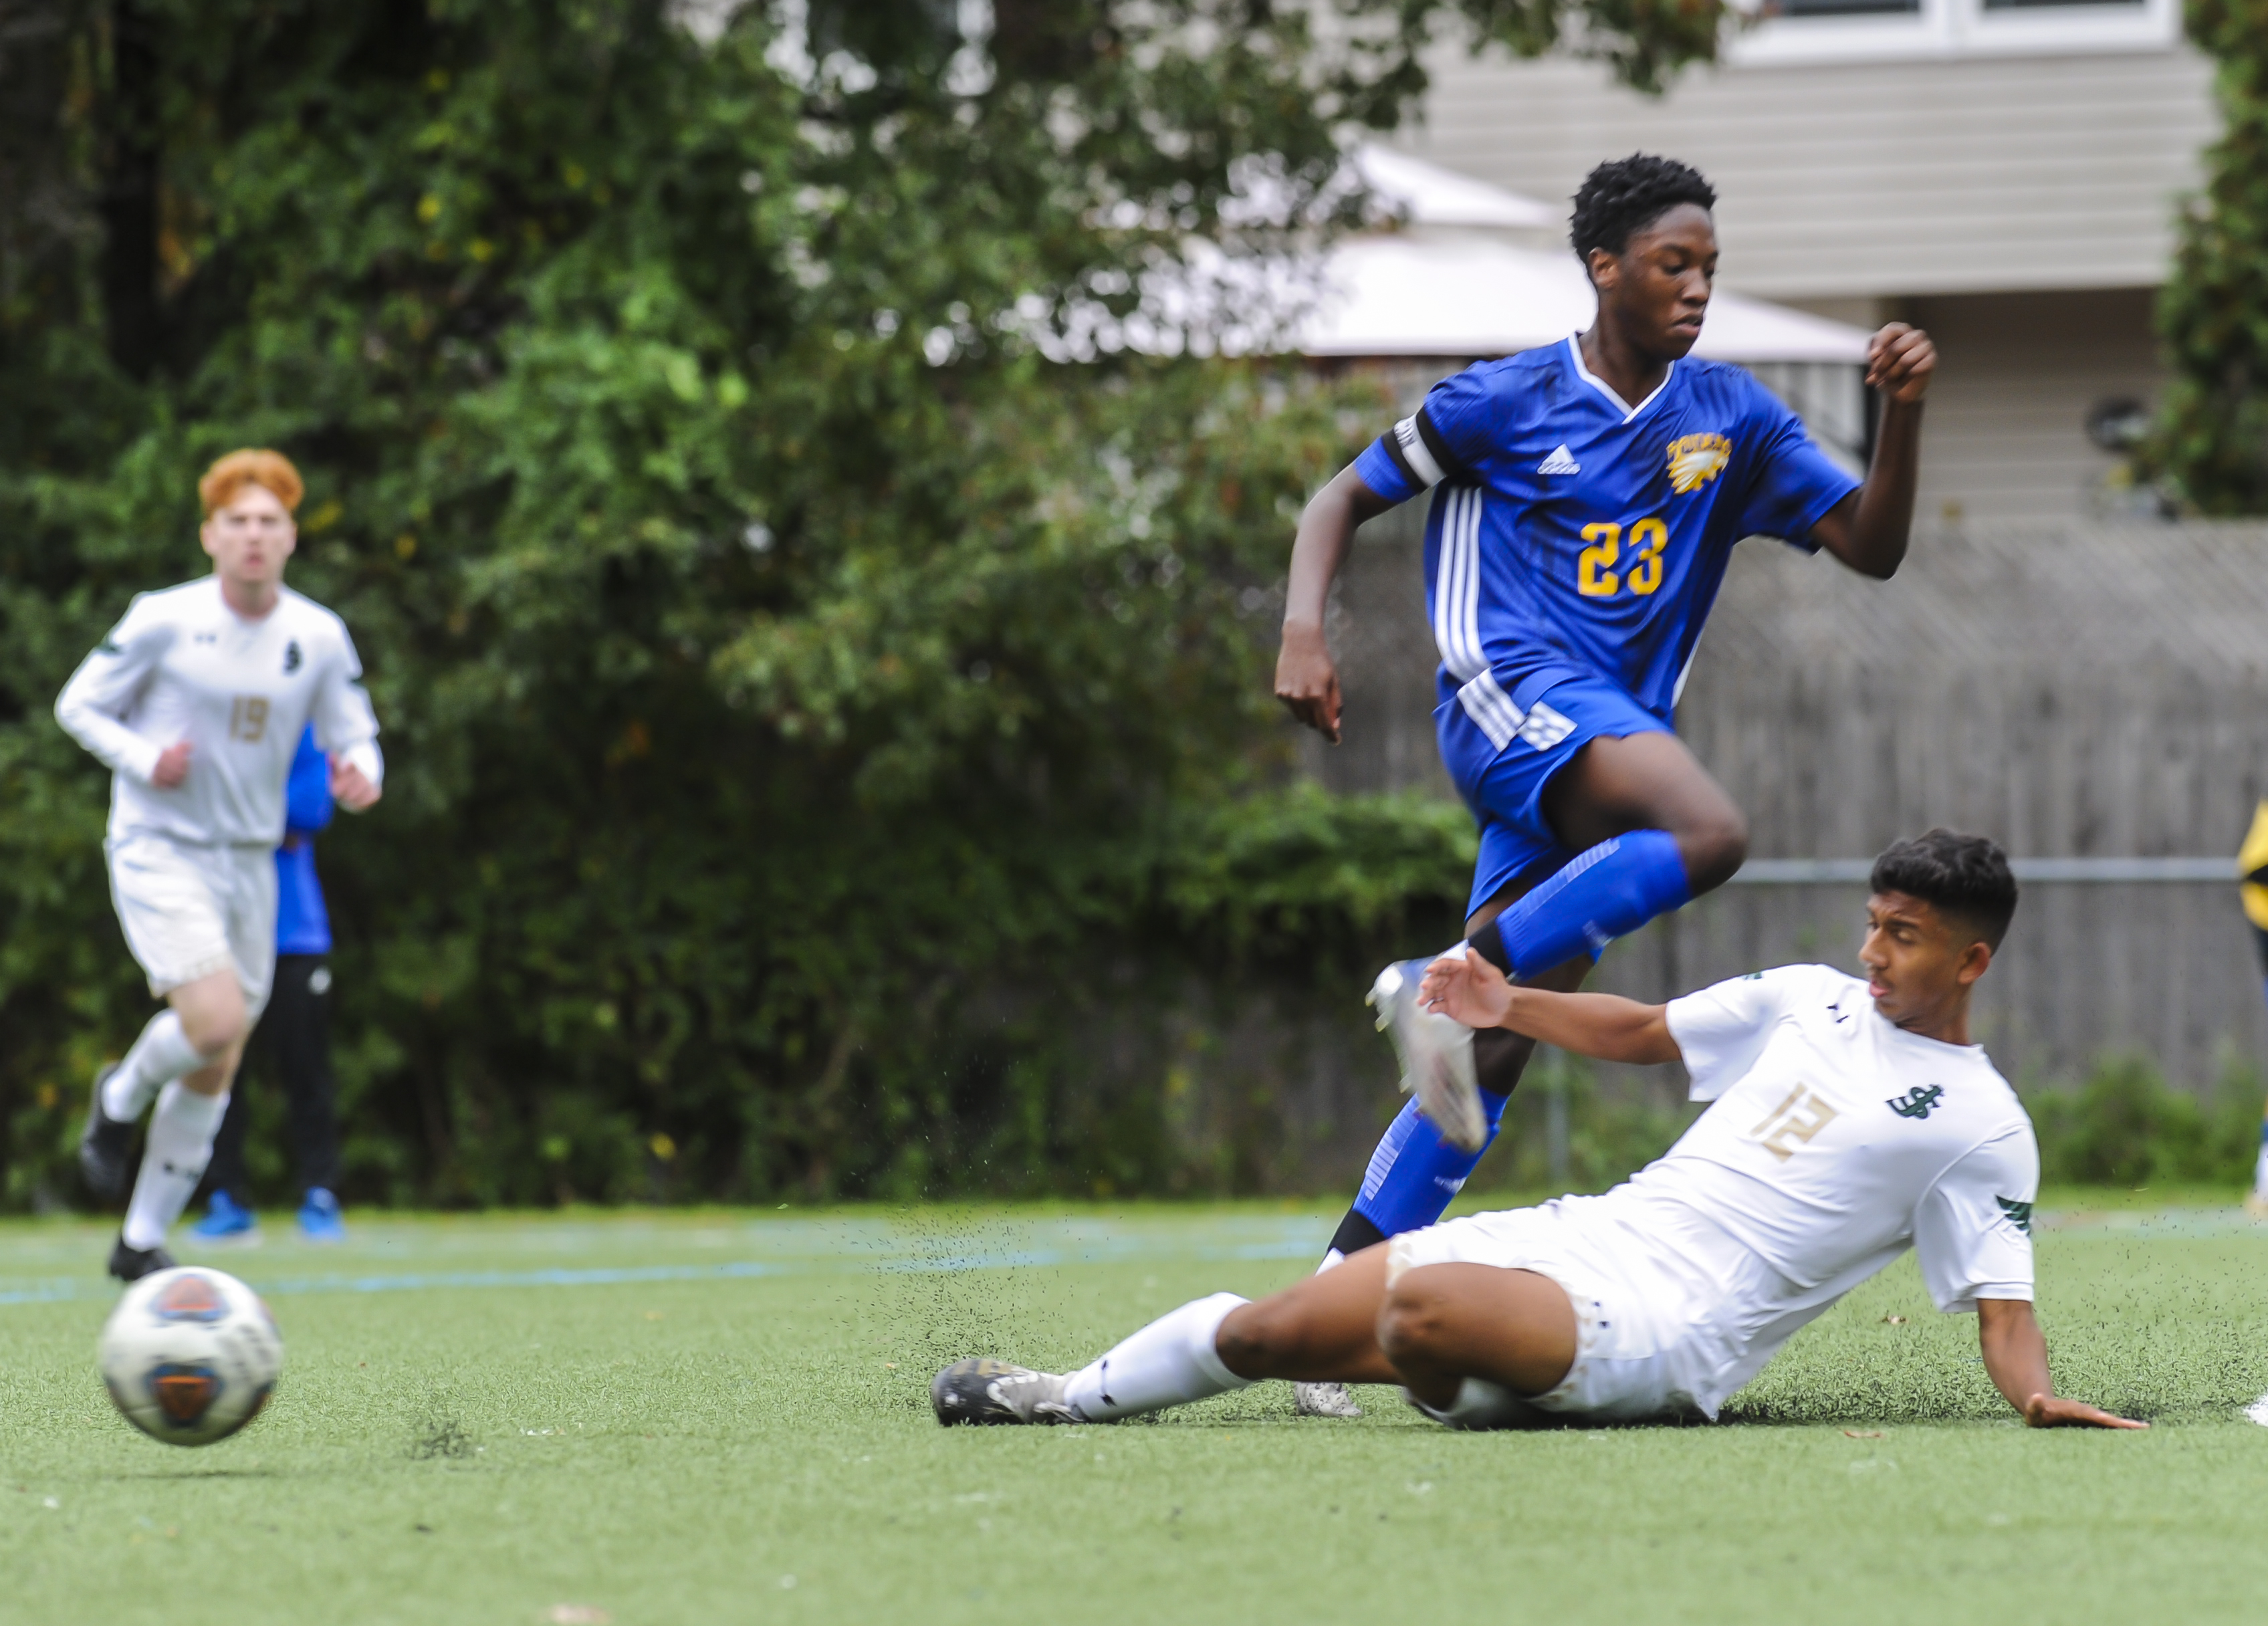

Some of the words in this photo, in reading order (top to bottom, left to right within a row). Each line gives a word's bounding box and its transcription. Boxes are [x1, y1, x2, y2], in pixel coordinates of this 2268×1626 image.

[1578, 517, 1668, 596] 23
[229, 695, 269, 743] 19
[1748, 1081, 1839, 1163] 12
